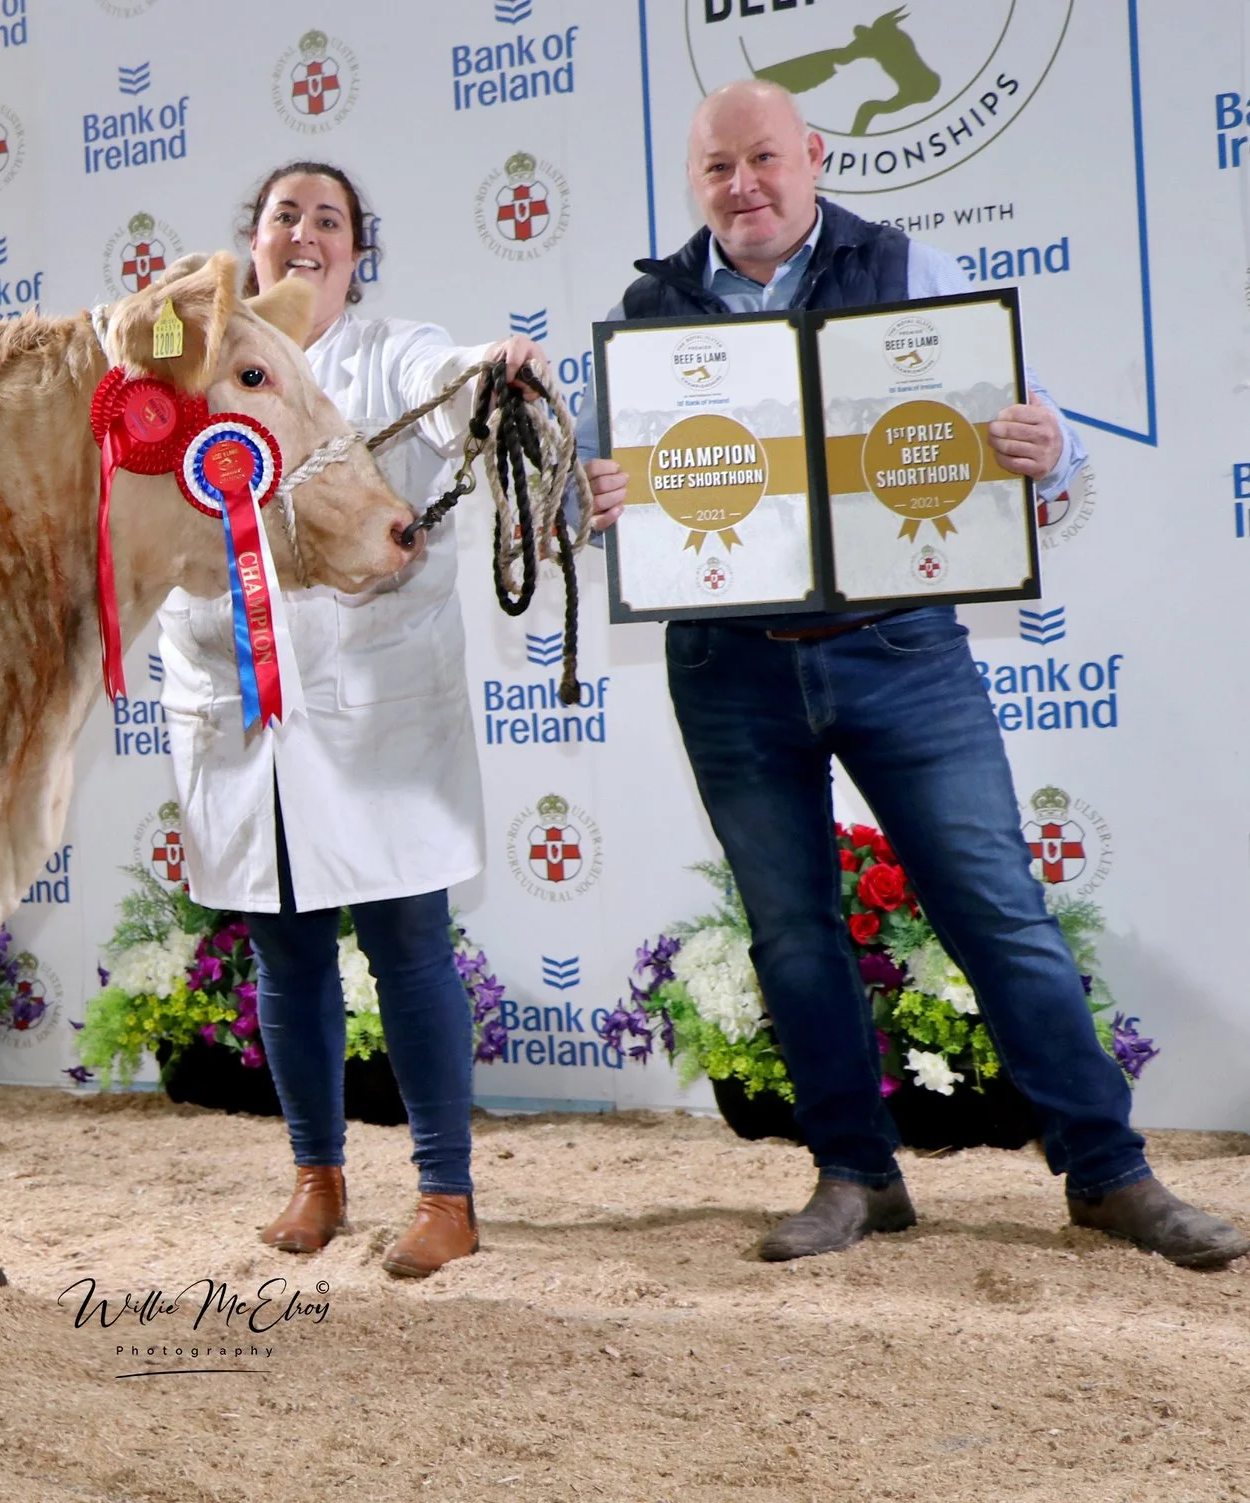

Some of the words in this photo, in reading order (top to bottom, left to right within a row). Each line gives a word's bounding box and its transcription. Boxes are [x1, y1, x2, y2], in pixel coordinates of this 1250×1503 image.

[275, 46, 298, 78] ROYAL
[330, 38, 357, 72] ULSTER
[452, 36, 537, 78] Bank
[542, 24, 578, 61] of
[454, 60, 575, 111] Ireland
[0, 105, 23, 137] ULSTER
[83, 106, 155, 144] Bank
[159, 96, 188, 130] of
[274, 85, 331, 134] AGRICULTURAL
[333, 78, 358, 124] SOCIETY
[3, 143, 24, 186] SOCIETY
[85, 129, 188, 174] Ireland
[476, 167, 503, 201] ROYAL
[539, 160, 570, 197] ULSTER
[475, 209, 541, 261] AGRICULTURAL
[543, 203, 571, 252] SOCIETY
[954, 202, 1015, 227] WITH
[103, 226, 127, 256] ROYAL
[159, 220, 185, 253] ULSTER
[956, 236, 1071, 283] eland
[15, 271, 45, 303] of
[673, 353, 694, 365] BEEF
[703, 351, 727, 363] LAMB
[885, 339, 906, 351] BEEF
[915, 335, 939, 348] LAMB
[885, 427, 906, 445] 1ST
[907, 421, 955, 444] PRIZE
[658, 443, 757, 470] CHAMPION
[901, 444, 941, 466] BEEF
[653, 473, 686, 491] BEEF
[687, 468, 764, 489] SHORTHORN
[876, 463, 971, 488] SHORTHORN
[695, 509, 727, 522] 2021
[909, 496, 941, 510] 2021
[1061, 491, 1096, 543] SOCIETY
[238, 551, 273, 666] CHAMPION
[1079, 654, 1124, 692] of
[114, 696, 167, 725] Ban
[485, 711, 607, 745] Ireland
[990, 693, 1118, 732] eland
[508, 806, 535, 838] ROYAL
[571, 803, 602, 843] ULSTER
[1073, 797, 1112, 844] ULSTER
[46, 845, 73, 874] of
[507, 847, 574, 904] AGRICULTURAL
[576, 849, 603, 897] SOCIETY
[1078, 848, 1114, 901] SOCIETY
[501, 999, 586, 1033] Bank
